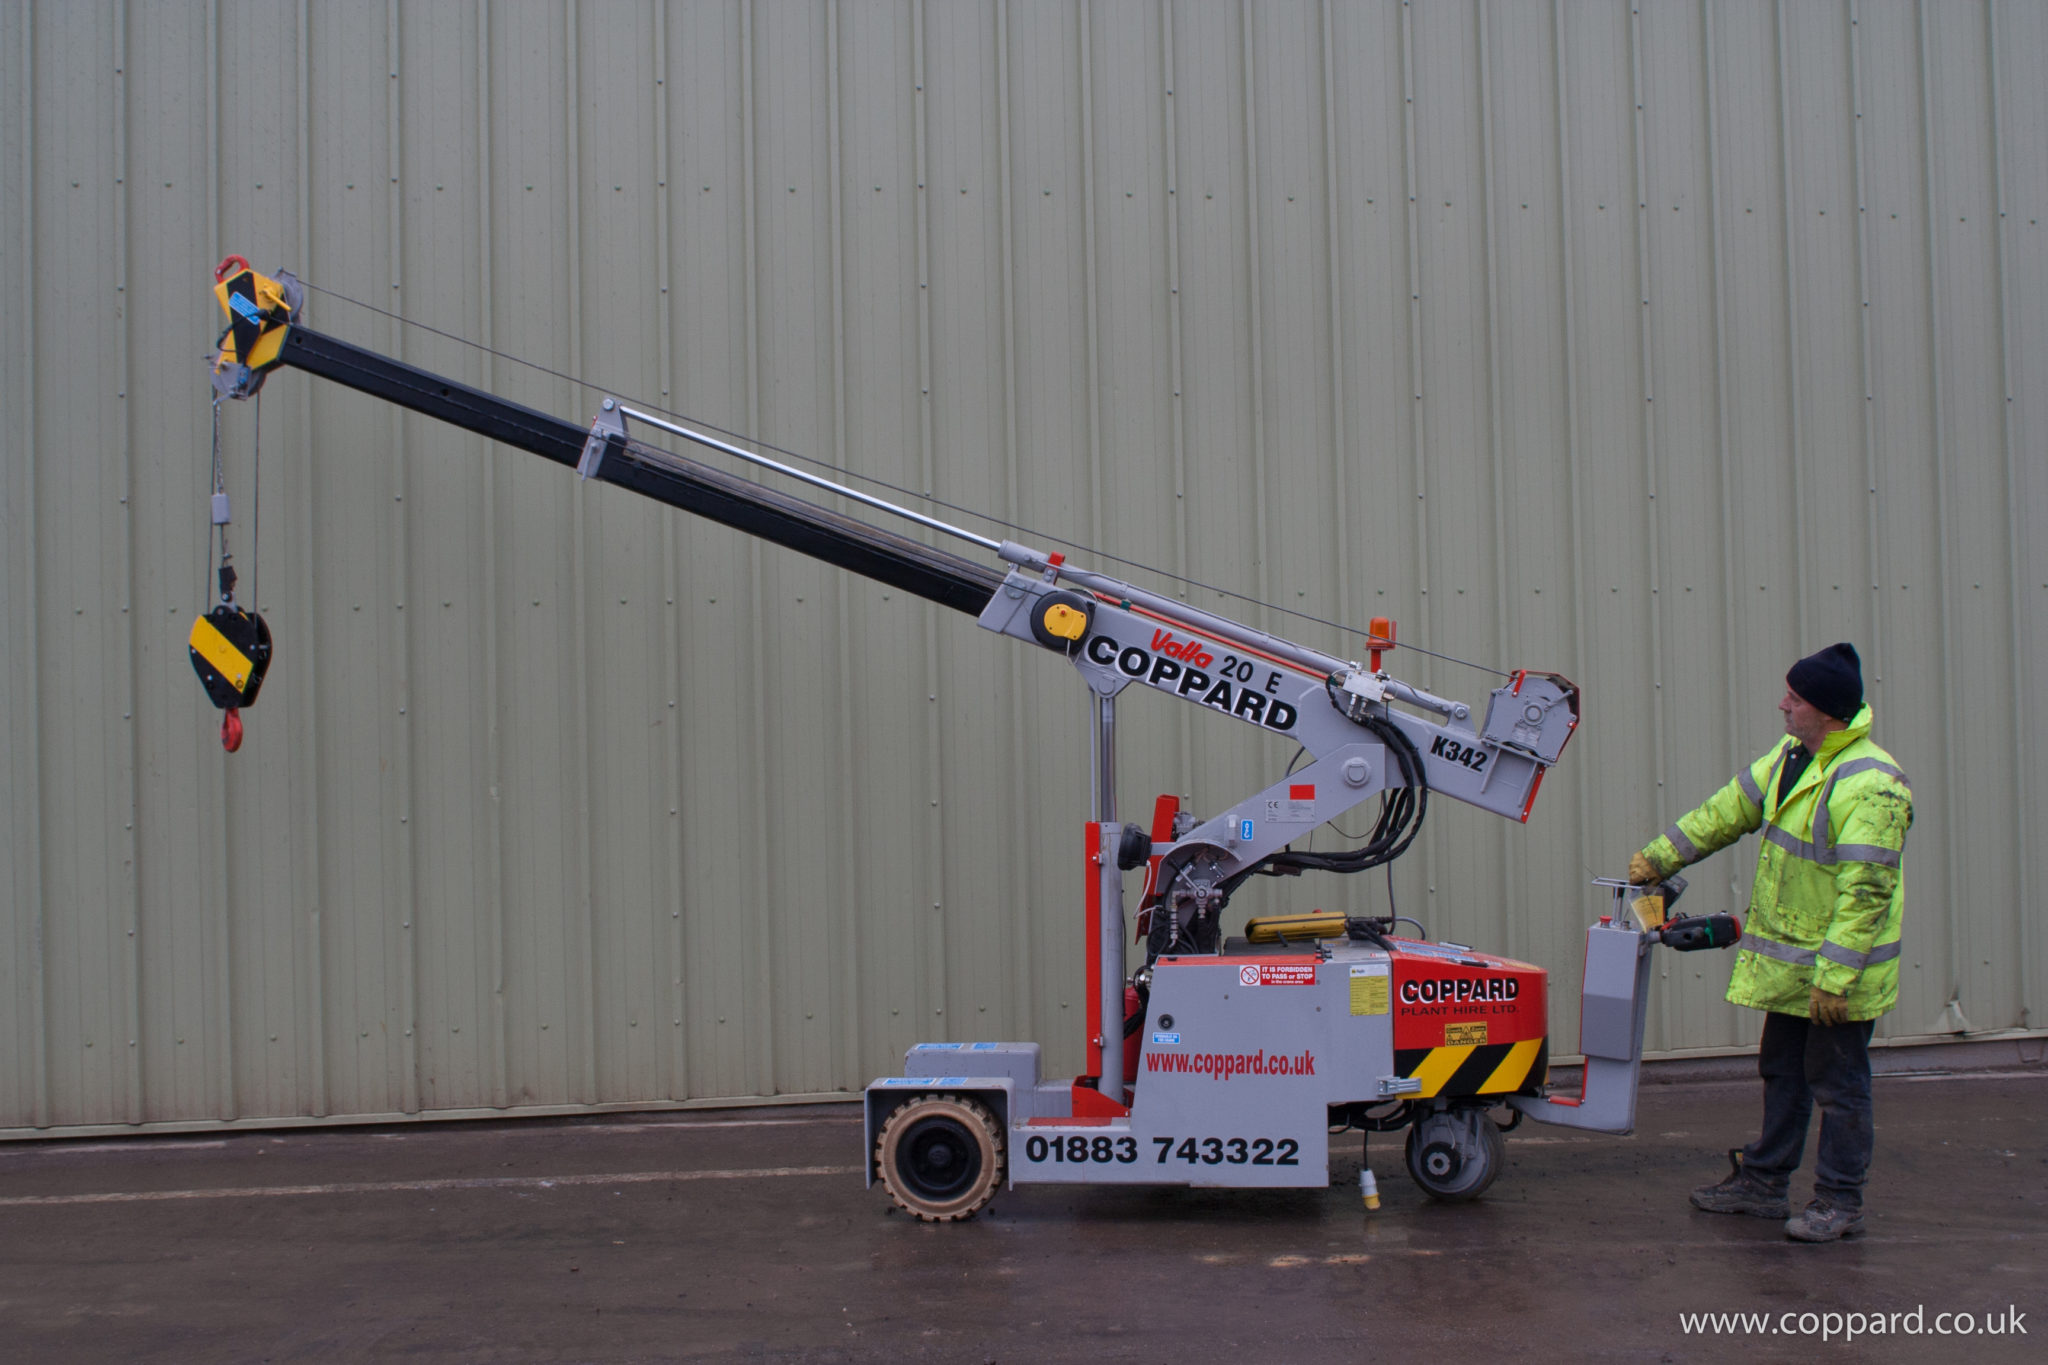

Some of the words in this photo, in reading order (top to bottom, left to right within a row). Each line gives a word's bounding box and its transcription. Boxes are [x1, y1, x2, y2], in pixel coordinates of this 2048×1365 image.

[1150, 628, 1214, 669] Valla
[1219, 655, 1254, 683] 20
[1265, 671, 1282, 694] E
[1084, 635, 1298, 731] COPPARD
[1430, 735, 1488, 772] K342
[1400, 978, 1519, 1004] COPPARD
[1401, 1006, 1448, 1016] PLANT
[1453, 1005, 1487, 1015] HIRE
[1492, 1004, 1520, 1015] LTD.
[1446, 1038, 1487, 1047] DANGER
[1146, 1049, 1315, 1081] www.coppard.co.uk
[1026, 1136, 1138, 1163] 01883
[1152, 1137, 1299, 1165] 743322
